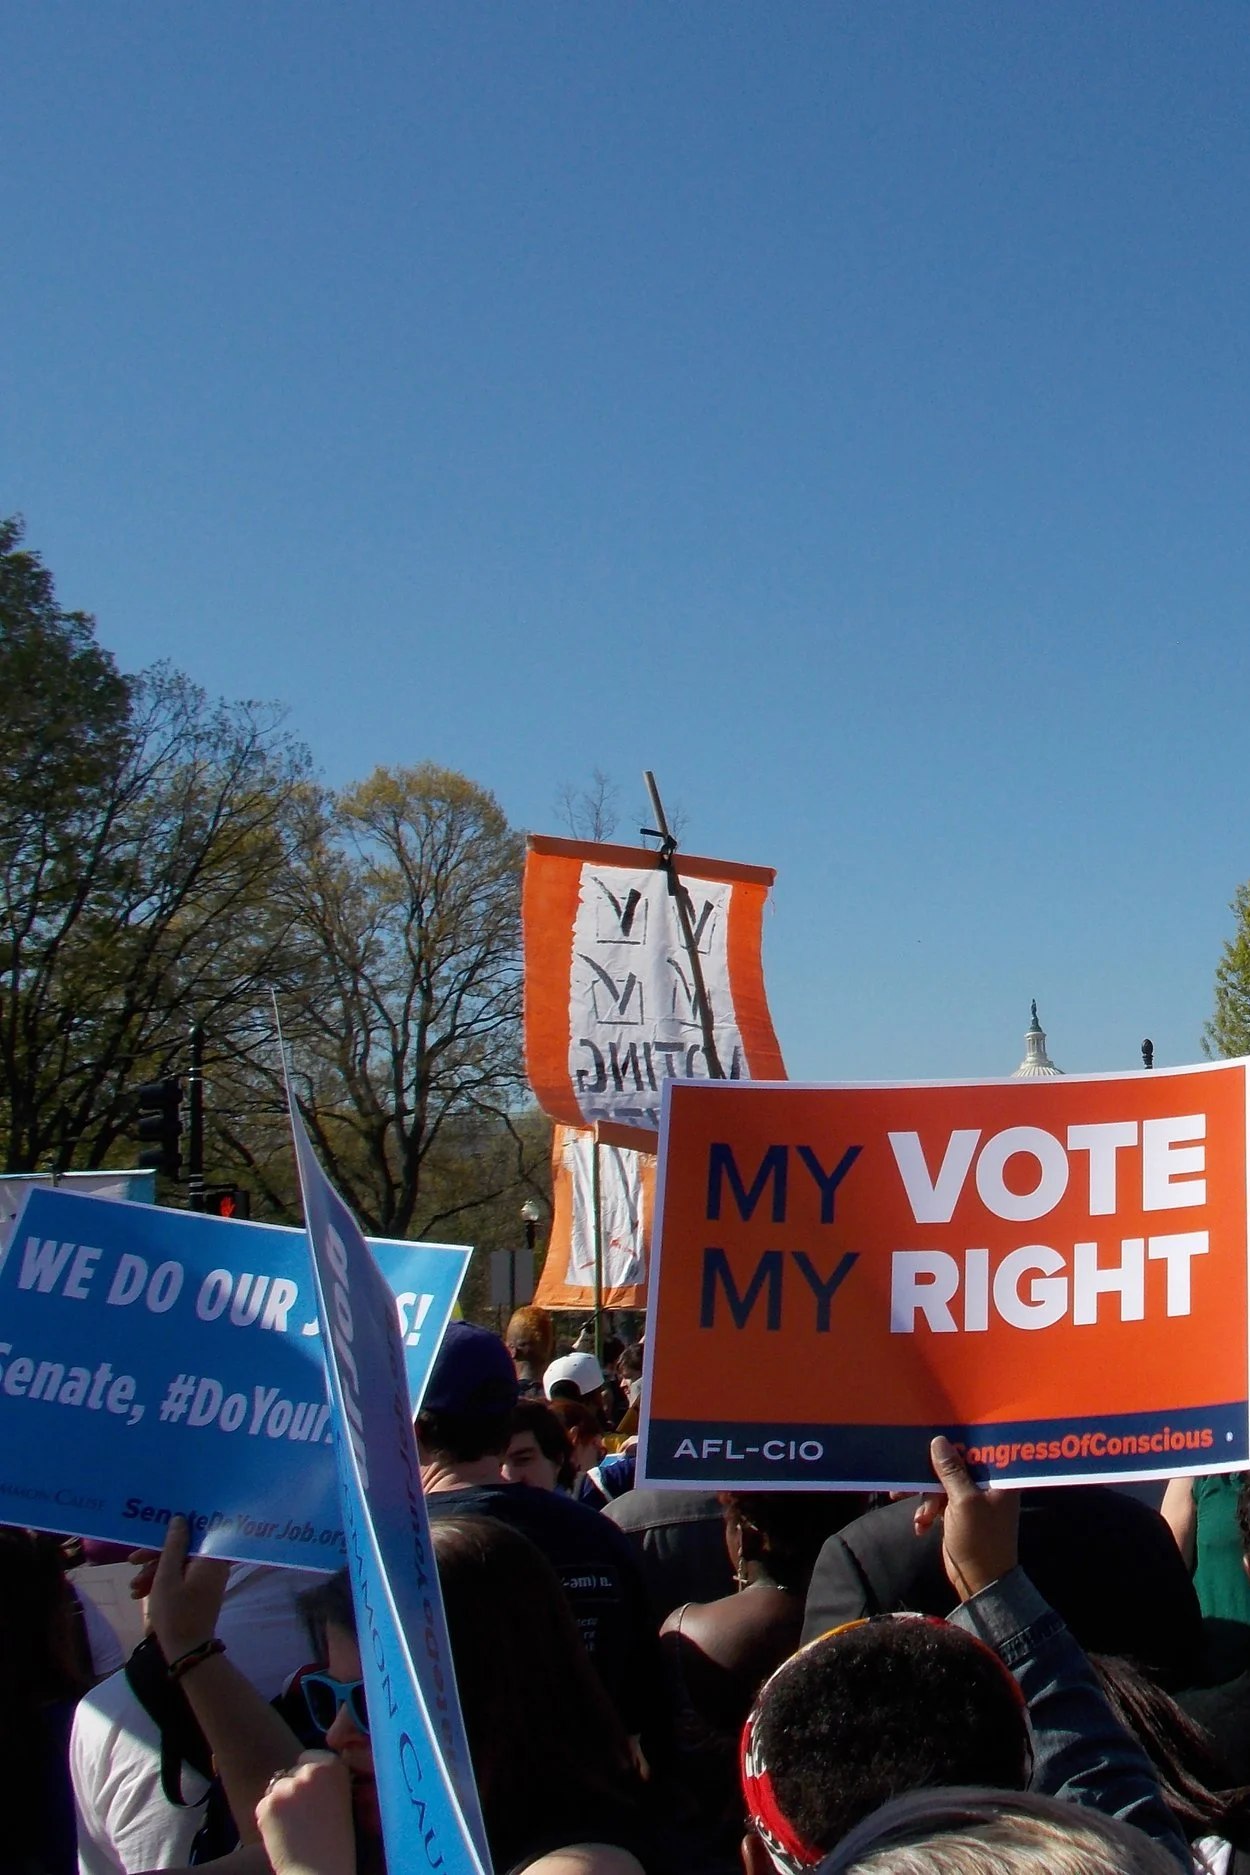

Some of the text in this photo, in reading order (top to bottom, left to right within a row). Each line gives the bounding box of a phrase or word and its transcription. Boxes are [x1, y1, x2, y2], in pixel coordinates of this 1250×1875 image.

[706, 1112, 1207, 1225] MY VOTE
[17, 1236, 299, 1333] WE DO OUR
[700, 1230, 1210, 1333] MY RIGHT
[159, 1373, 334, 1445] #DoYour
[673, 1438, 825, 1462] AFL-CIO
[399, 1731, 448, 1875] CAU
